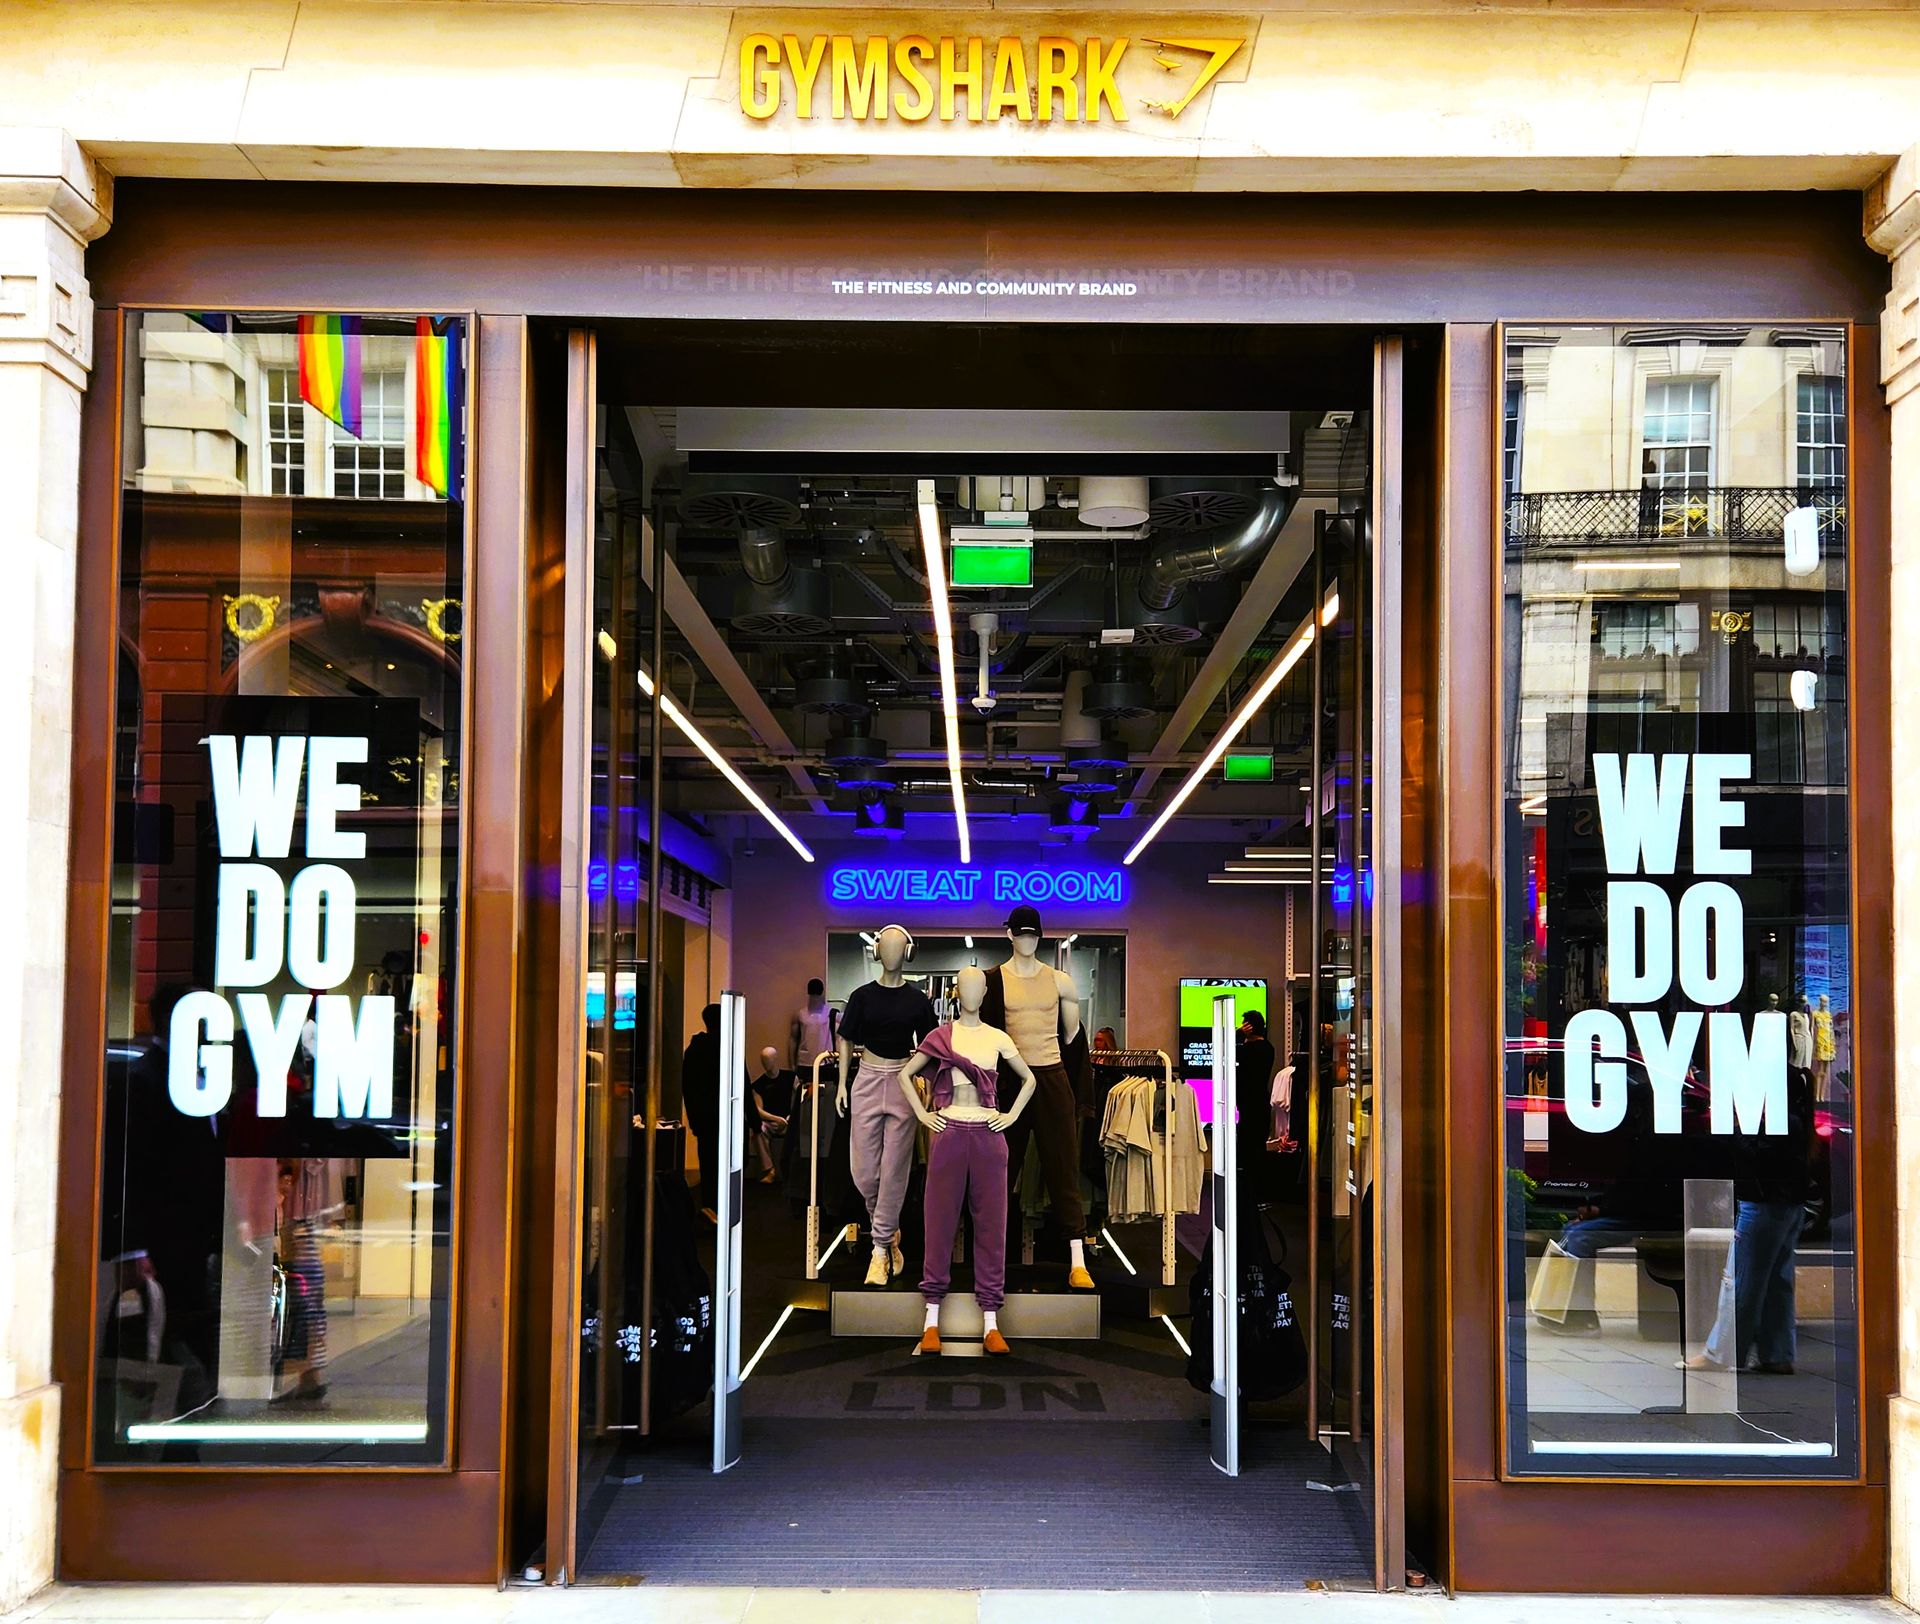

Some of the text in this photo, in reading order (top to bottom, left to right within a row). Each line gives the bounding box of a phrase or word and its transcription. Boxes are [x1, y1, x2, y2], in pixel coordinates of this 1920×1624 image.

[740, 33, 1130, 121] GYMSHARK
[832, 281, 1137, 295] THE FITNESS AND COMMUNITY BRAND
[208, 735, 369, 858] WE
[1592, 753, 1752, 875] WE
[216, 863, 356, 990] DO
[832, 869, 1121, 901] SWEAT ROOM
[1607, 881, 1744, 1006] DO
[168, 991, 395, 1118] GYM
[1564, 1009, 1788, 1136] GYM
[844, 1381, 1107, 1412] LDN
